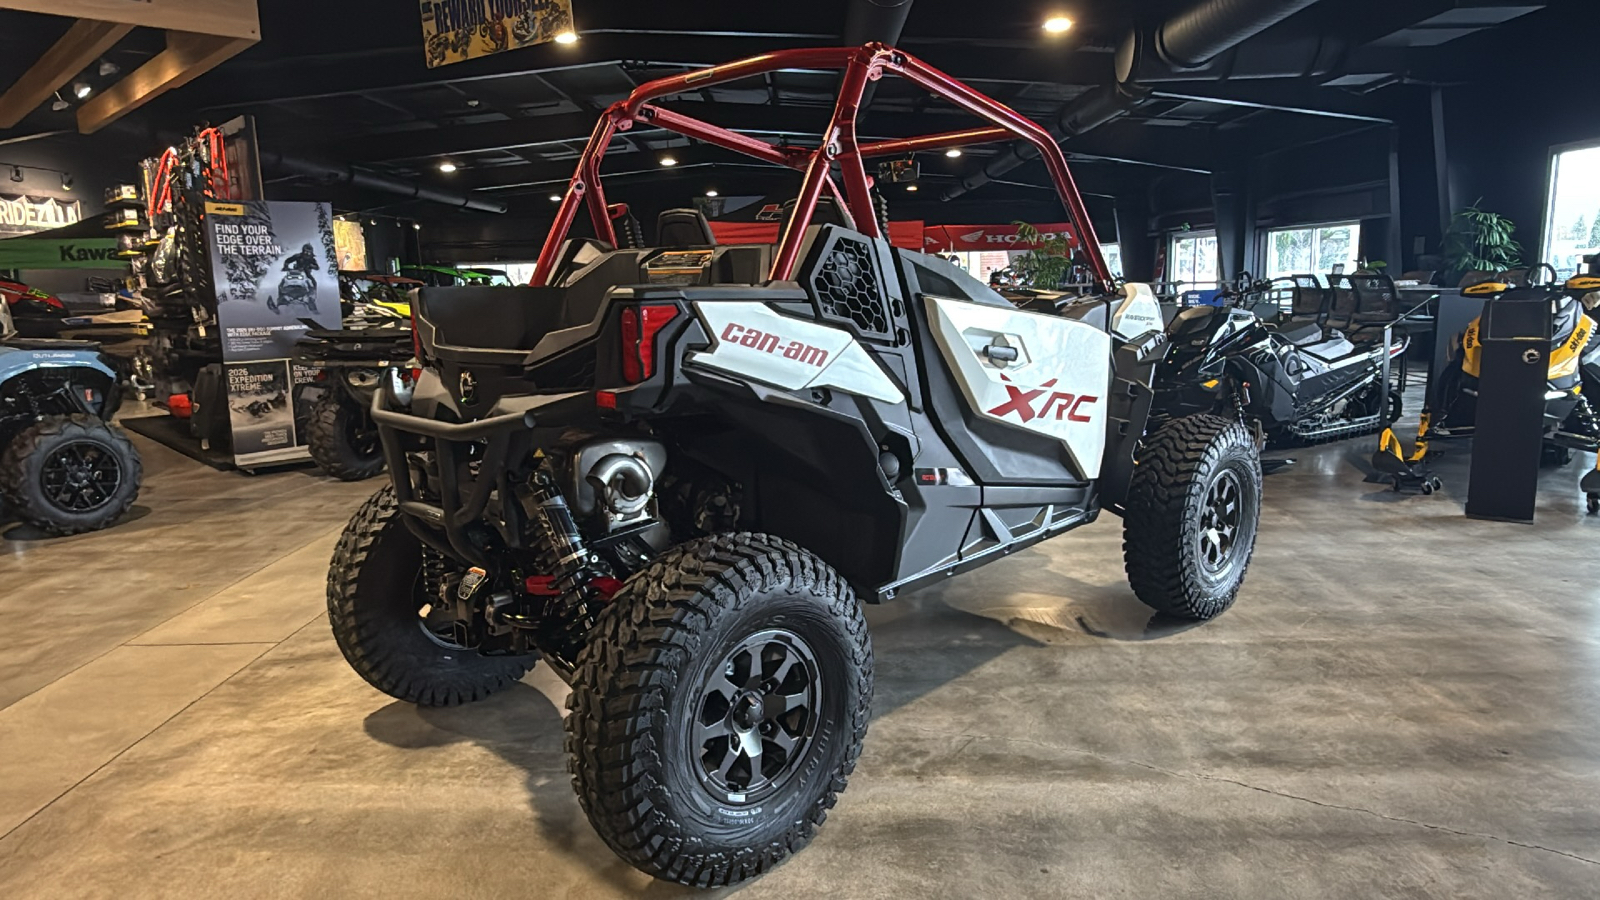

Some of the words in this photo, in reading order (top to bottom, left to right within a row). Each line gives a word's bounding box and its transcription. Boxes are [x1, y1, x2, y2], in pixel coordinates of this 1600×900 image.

[434, 0, 487, 34] REWARD
[215, 224, 239, 235] FIND
[241, 225, 268, 235] YOUR
[216, 235, 243, 244] EDGE
[245, 235, 272, 245] OVER
[986, 231, 1073, 243] HODA
[60, 244, 118, 261] Kawa
[217, 245, 238, 254] THE
[721, 322, 829, 367] can-am
[229, 374, 274, 384] EXPEDITION
[231, 383, 262, 392] XTREME
